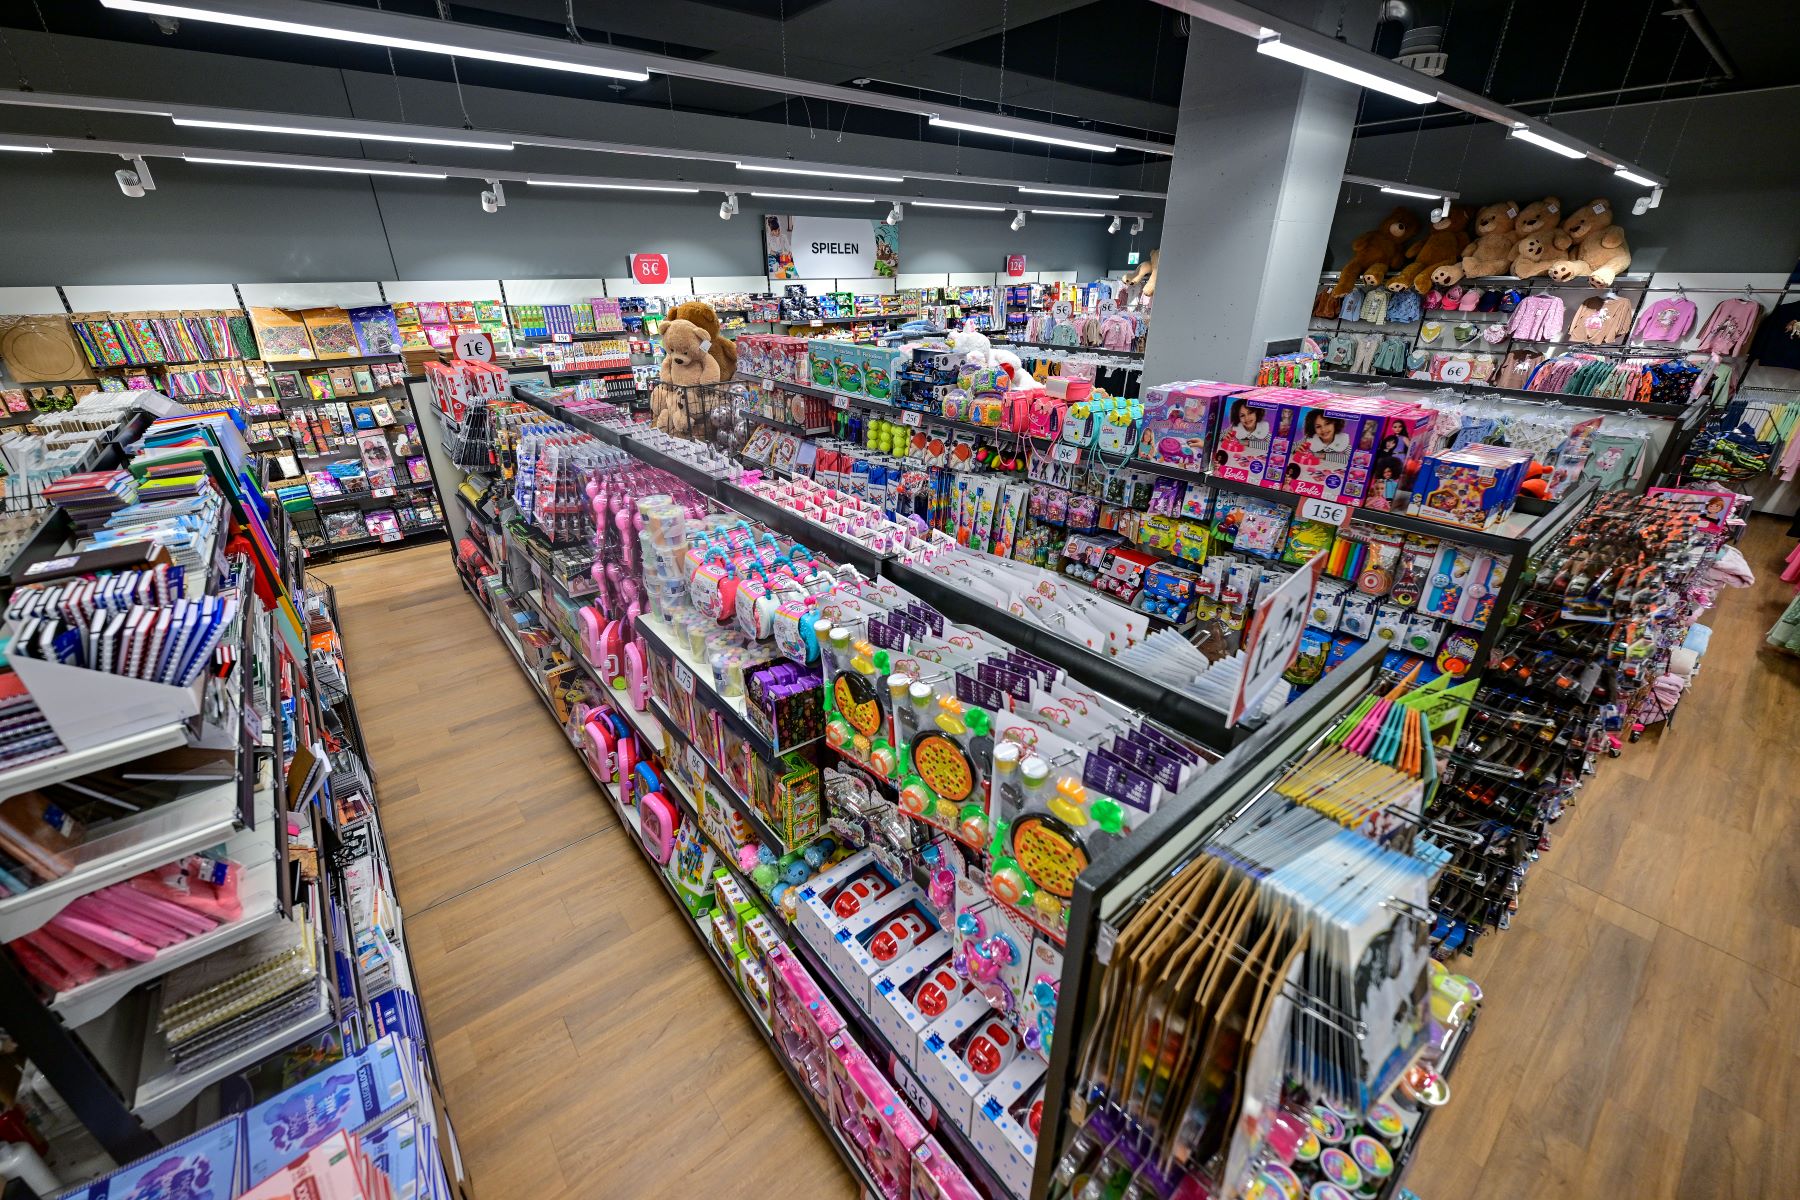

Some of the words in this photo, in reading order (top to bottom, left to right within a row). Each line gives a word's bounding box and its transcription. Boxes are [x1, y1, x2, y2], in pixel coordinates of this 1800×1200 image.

[811, 242, 859, 254] SPIELEN
[642, 262, 660, 276] 8€
[1009, 261, 1023, 271] 12€
[1056, 305, 1069, 315] 5€
[1101, 302, 1114, 312] 8€
[463, 341, 485, 357] 1€
[1447, 366, 1464, 377] 6€
[905, 413, 918, 424] 25€
[1059, 447, 1072, 459] 8€
[1223, 467, 1247, 481] Barbie
[1294, 480, 1321, 497] Barbie
[1311, 503, 1343, 523] 15€
[676, 664, 692, 689] 1.75
[691, 754, 701, 772] 8€
[357, 1067, 372, 1110] COLLEGEBLOCK
[901, 1072, 929, 1114] 13€
[325, 1092, 336, 1115] MAKE
[304, 1093, 319, 1133] SOMETHING
